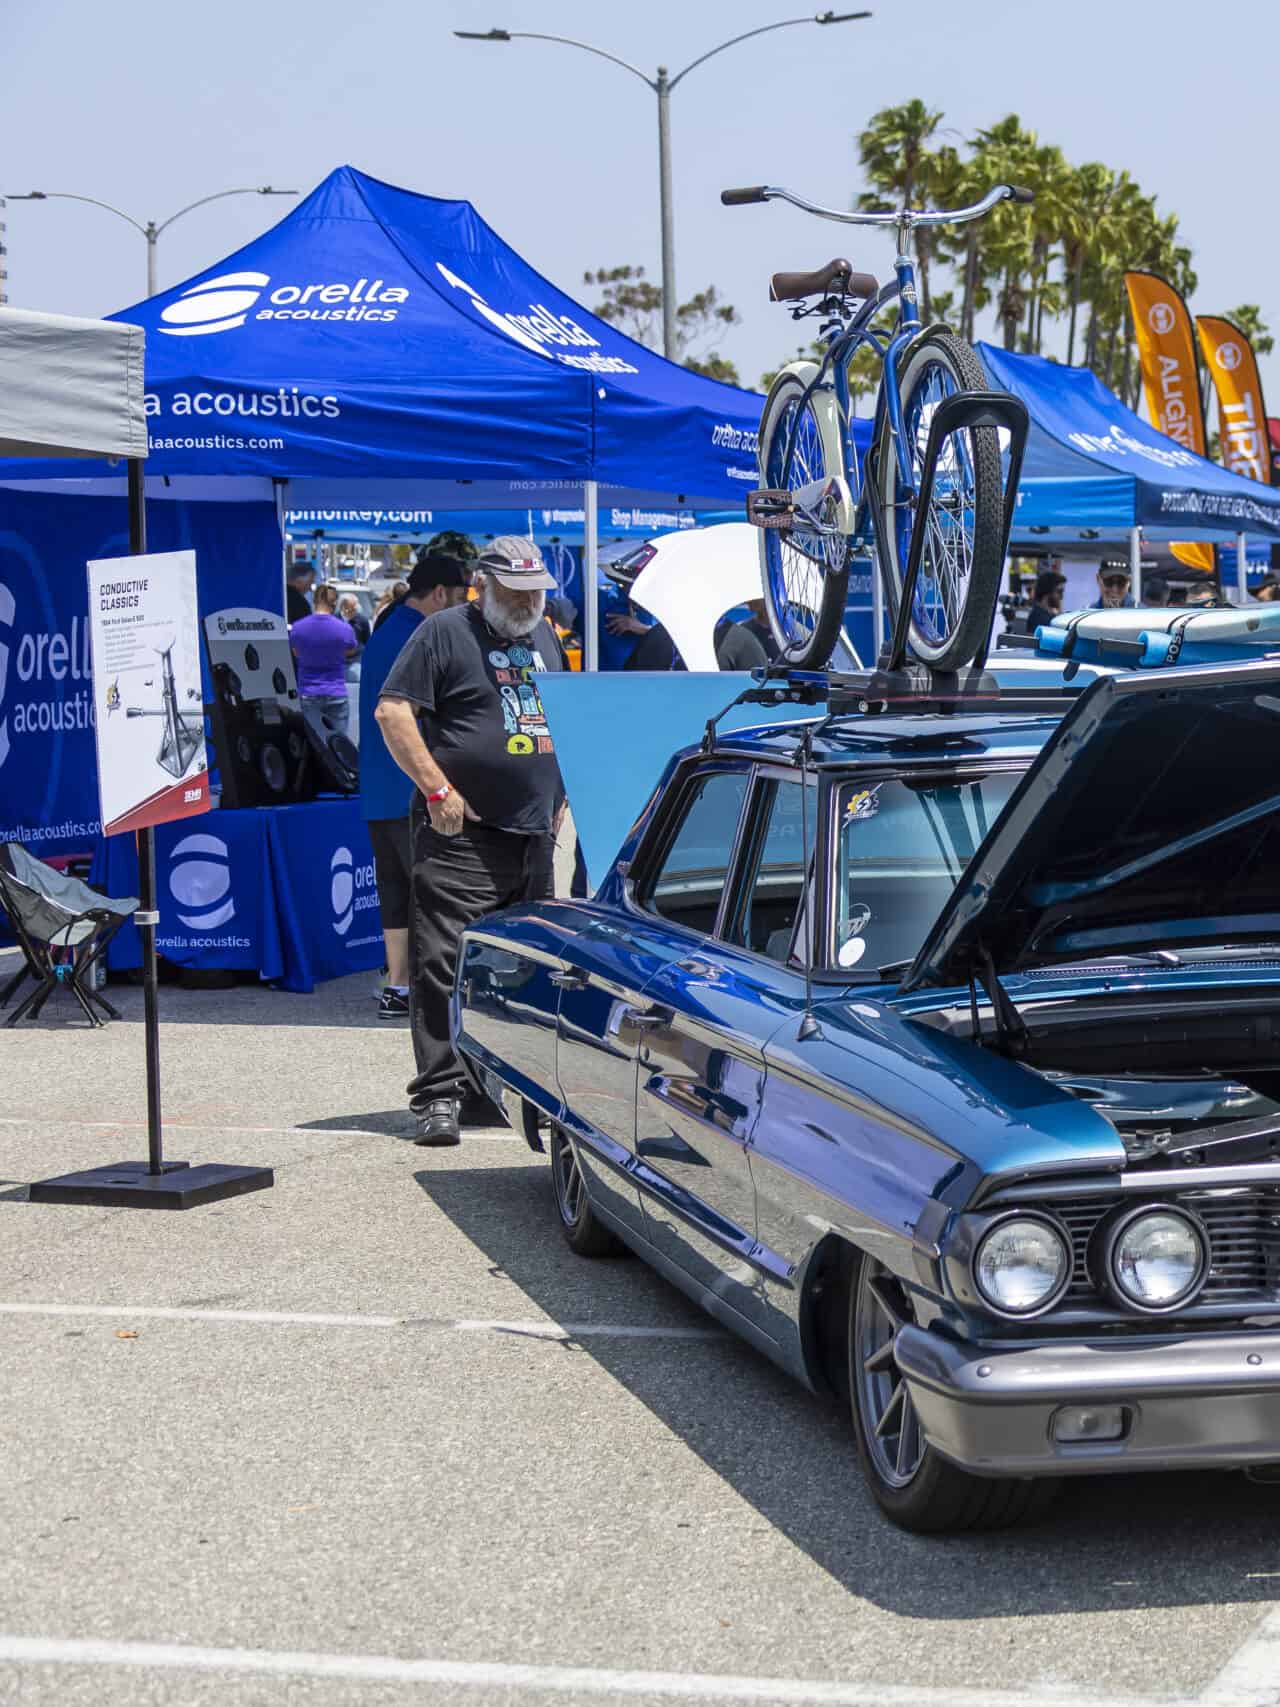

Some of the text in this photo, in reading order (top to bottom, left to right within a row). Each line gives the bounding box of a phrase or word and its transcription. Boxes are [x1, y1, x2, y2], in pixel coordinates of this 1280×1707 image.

[270, 279, 409, 305] orella
[256, 306, 398, 322] acoustics
[171, 387, 340, 417] acoustics
[1158, 355, 1190, 449] ALIGN
[148, 435, 284, 449] laacoustics.com
[100, 578, 149, 597] CONDUCTIVE
[100, 595, 140, 611] CLASSICS
[16, 616, 94, 682] orell
[14, 690, 96, 733] acousti
[0, 820, 102, 843] orellaacoustics.co
[355, 855, 377, 889] orel
[189, 935, 251, 948] acoustics
